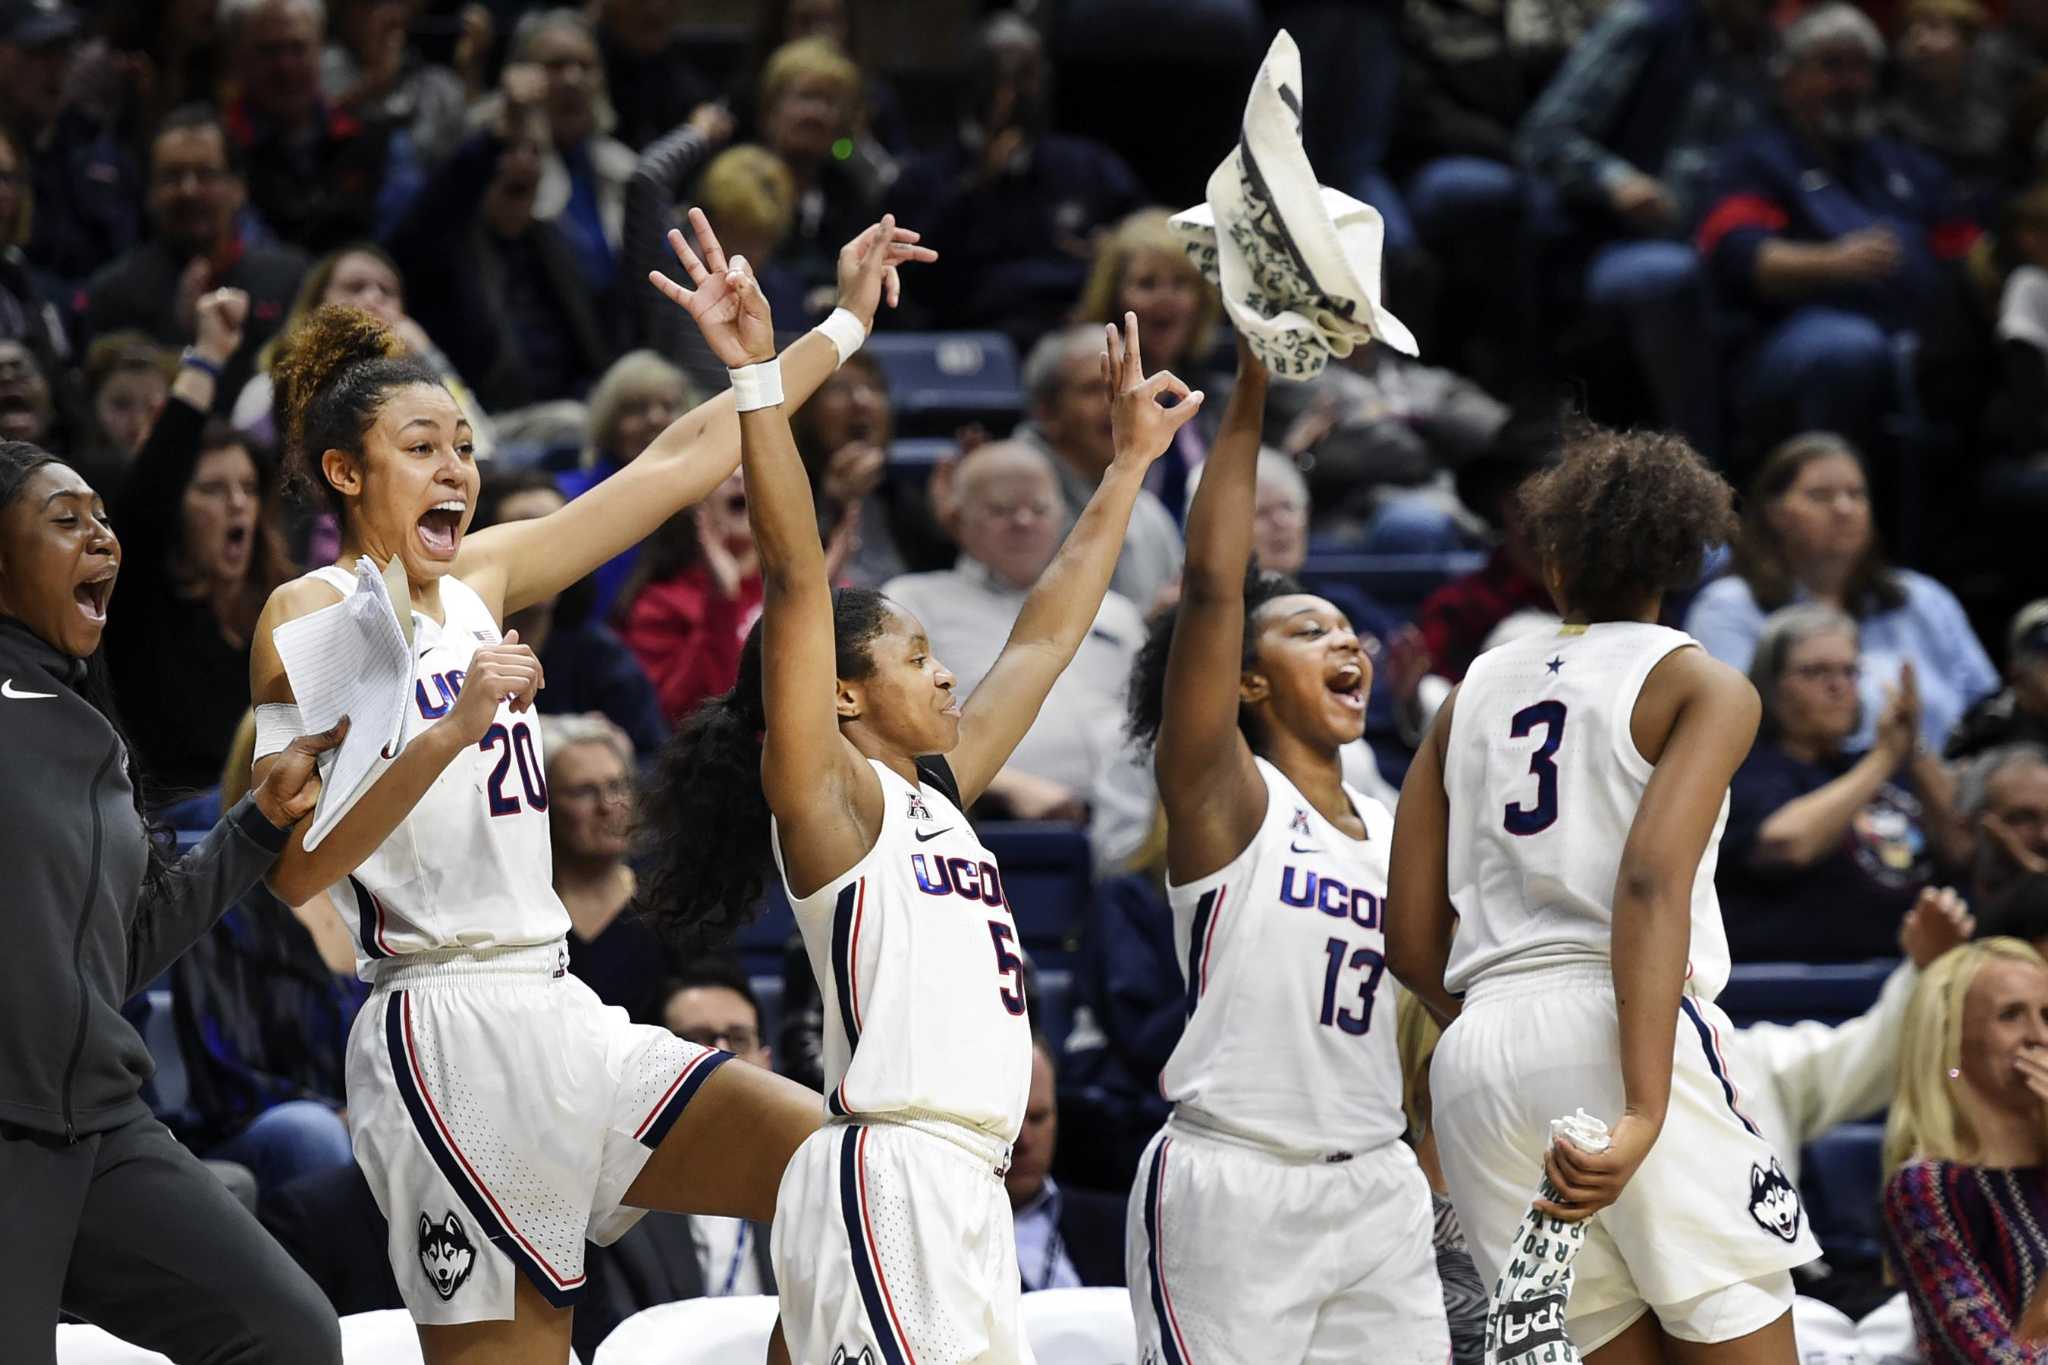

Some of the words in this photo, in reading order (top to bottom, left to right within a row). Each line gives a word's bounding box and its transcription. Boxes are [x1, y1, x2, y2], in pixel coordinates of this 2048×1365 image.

[479, 722, 548, 817] 20
[1503, 699, 1568, 836] 3
[911, 853, 1011, 914] UCO
[987, 919, 1026, 1017] 5
[1319, 936, 1386, 1036] 13
